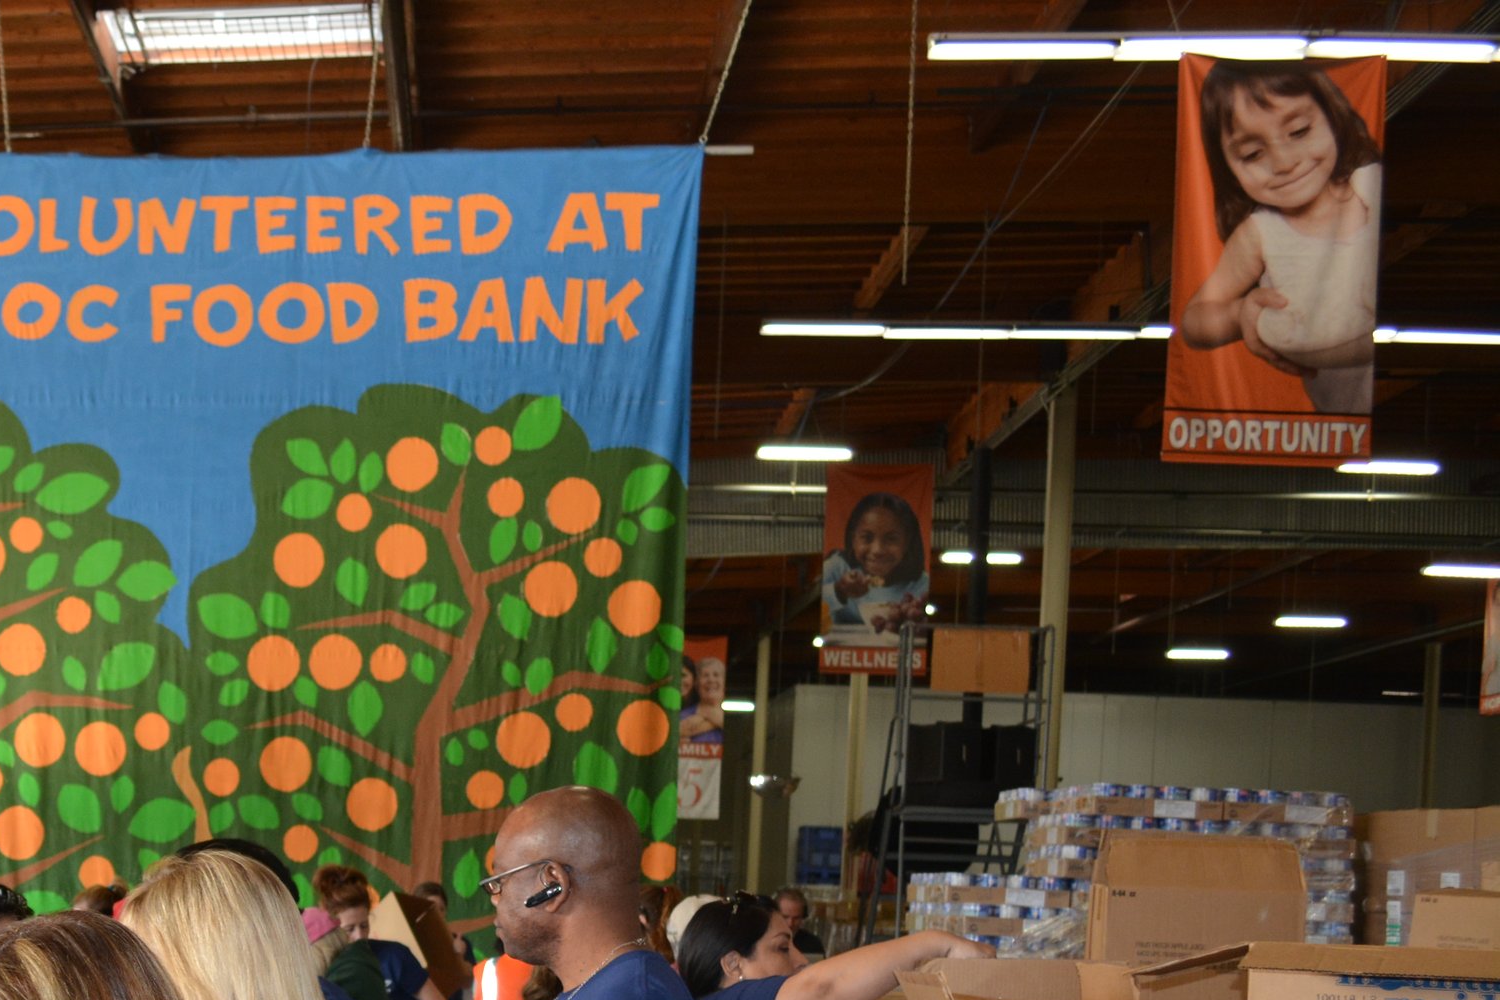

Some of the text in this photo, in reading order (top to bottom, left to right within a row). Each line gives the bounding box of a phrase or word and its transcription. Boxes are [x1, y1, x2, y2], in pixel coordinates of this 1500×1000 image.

[546, 191, 662, 254] AT
[1, 281, 120, 344] OC
[150, 281, 380, 348] FOOD
[402, 276, 646, 346] BANK
[1168, 416, 1368, 454] OPPORTUNITY
[822, 650, 923, 669] WELLNES
[678, 743, 721, 758] MILY
